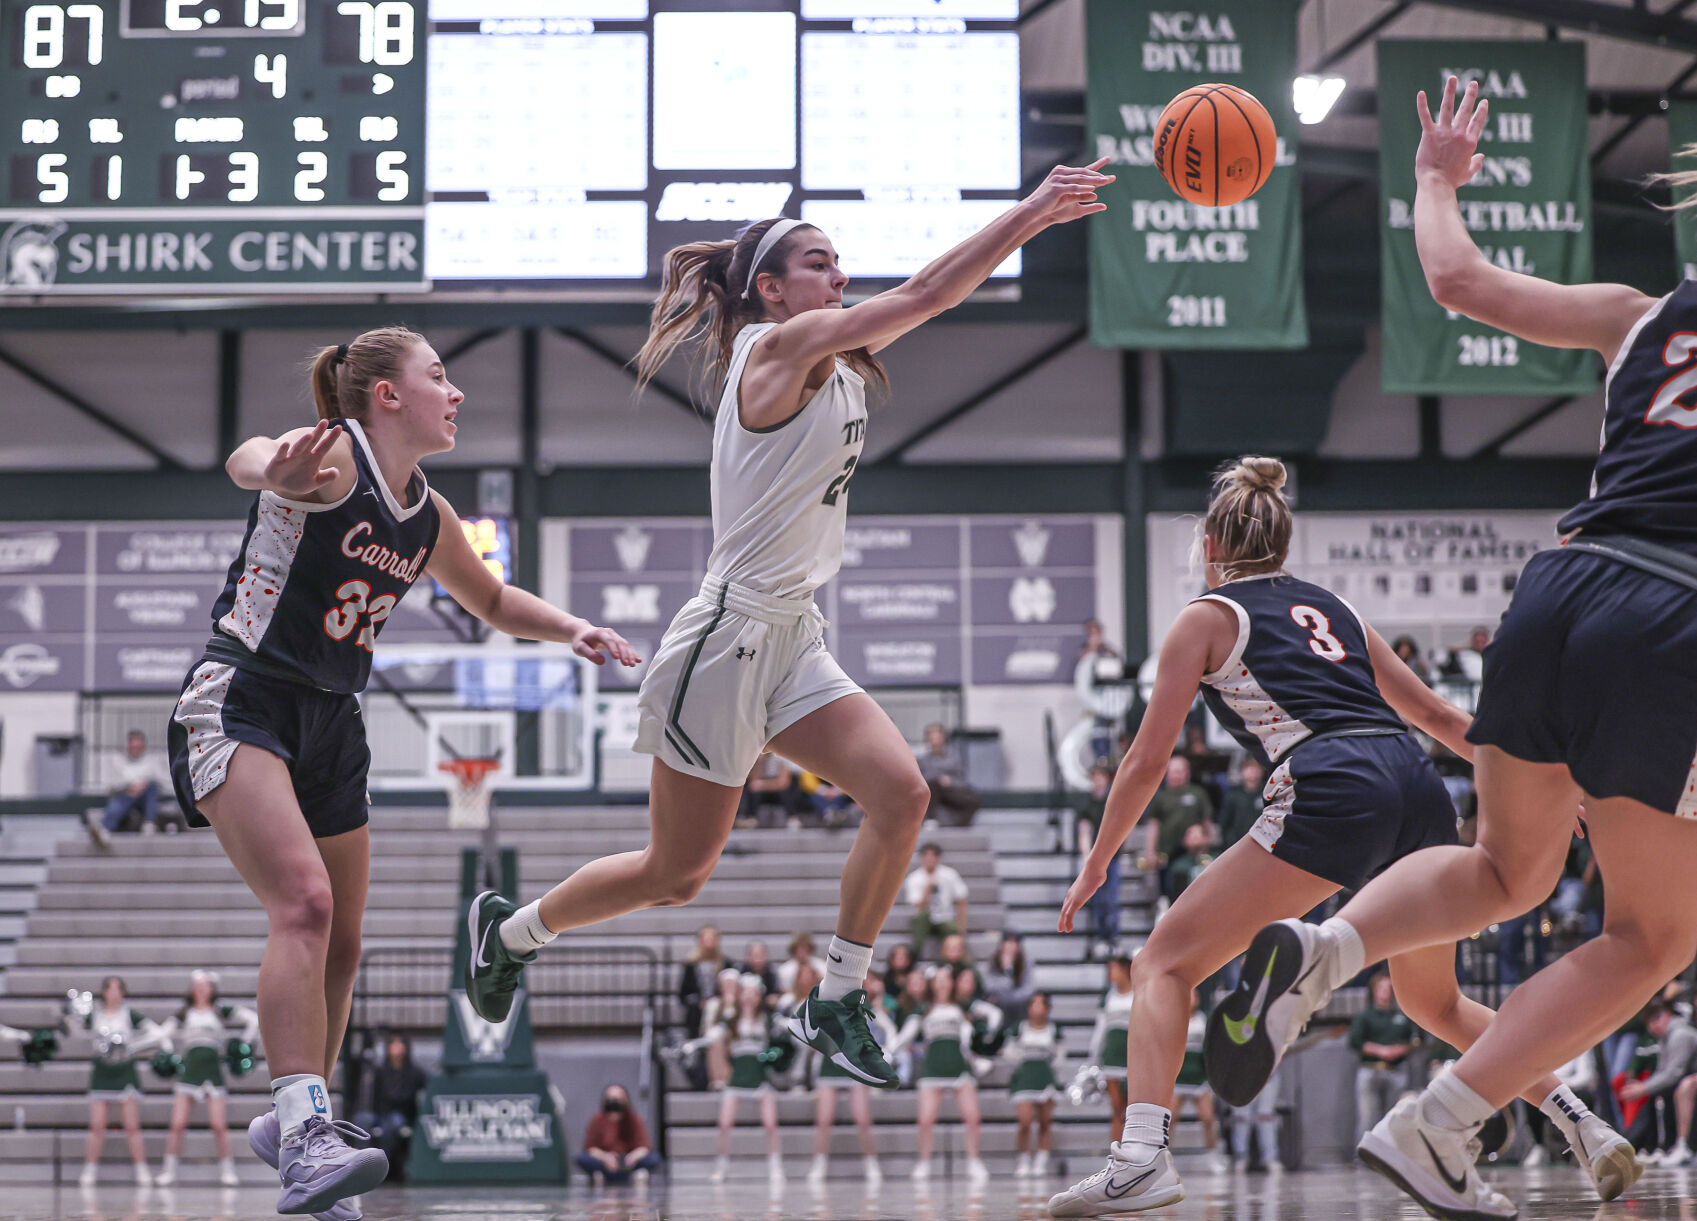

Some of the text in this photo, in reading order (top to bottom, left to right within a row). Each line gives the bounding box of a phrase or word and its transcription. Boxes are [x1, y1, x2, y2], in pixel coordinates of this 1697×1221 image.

[23, 4, 103, 68] 87
[337, 1, 414, 65] 78
[1149, 12, 1235, 41] NCAA
[254, 54, 287, 99] 4
[1142, 43, 1242, 72] DIV. III
[37, 153, 69, 202] 5
[294, 151, 328, 201] 2
[376, 150, 409, 201] 5
[1132, 200, 1260, 231] FOURTH
[66, 232, 214, 274] SHIRK
[228, 231, 419, 274] CENTER
[1146, 231, 1249, 263] PLACE
[1167, 295, 1227, 327] 2011
[1457, 334, 1520, 367] 2012
[341, 519, 428, 585] Carroll
[1328, 541, 1392, 563] HALL
[1403, 541, 1435, 564] OF
[1370, 519, 1499, 543] NATIONAL
[1289, 604, 1347, 663] 3
